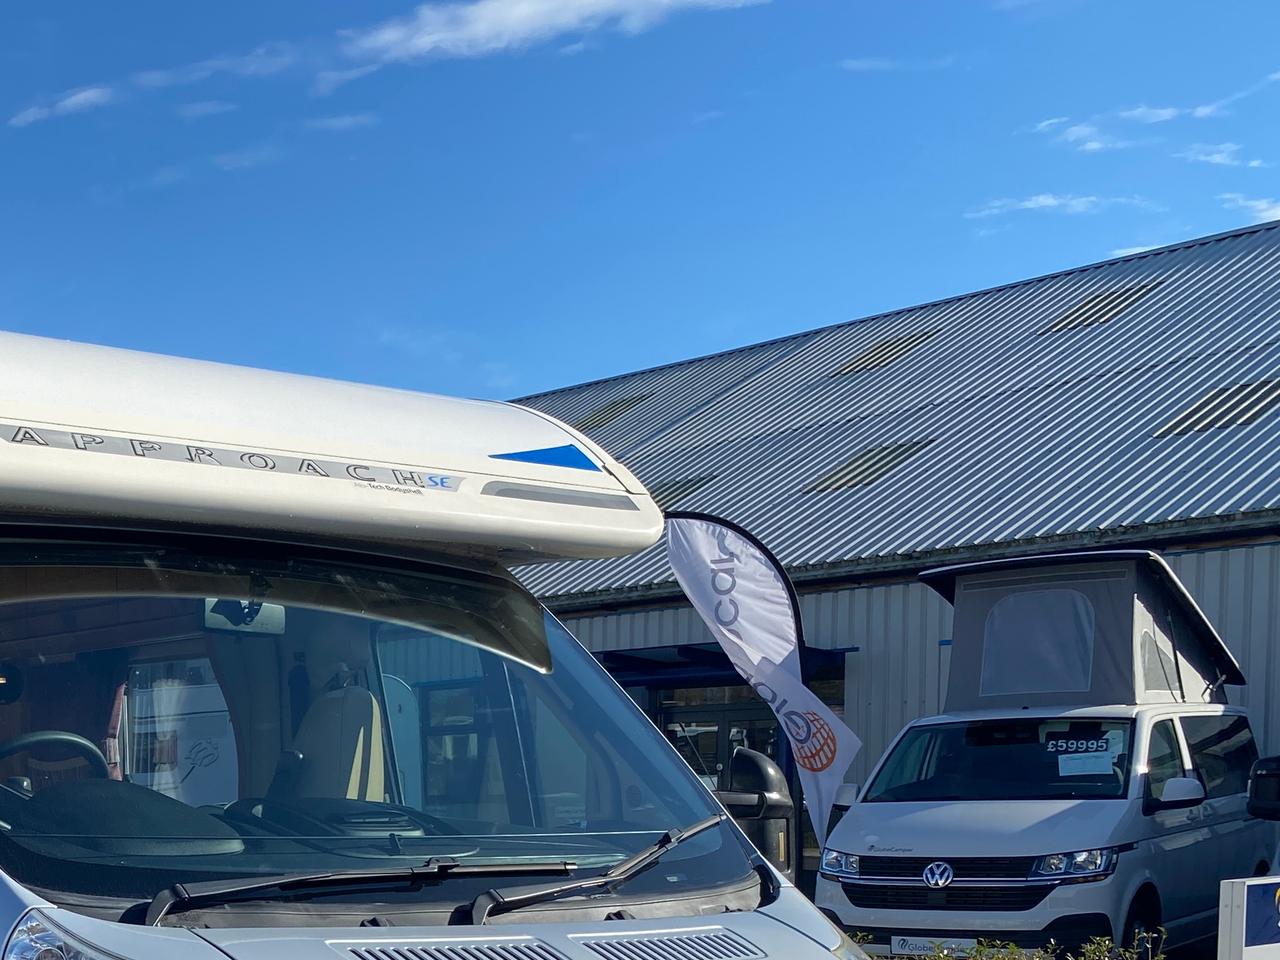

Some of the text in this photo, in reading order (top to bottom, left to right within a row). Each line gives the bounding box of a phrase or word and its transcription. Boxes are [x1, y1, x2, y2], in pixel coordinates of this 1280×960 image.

[11, 426, 452, 488] APPROACH SE
[1047, 740, 1107, 752] £59995
